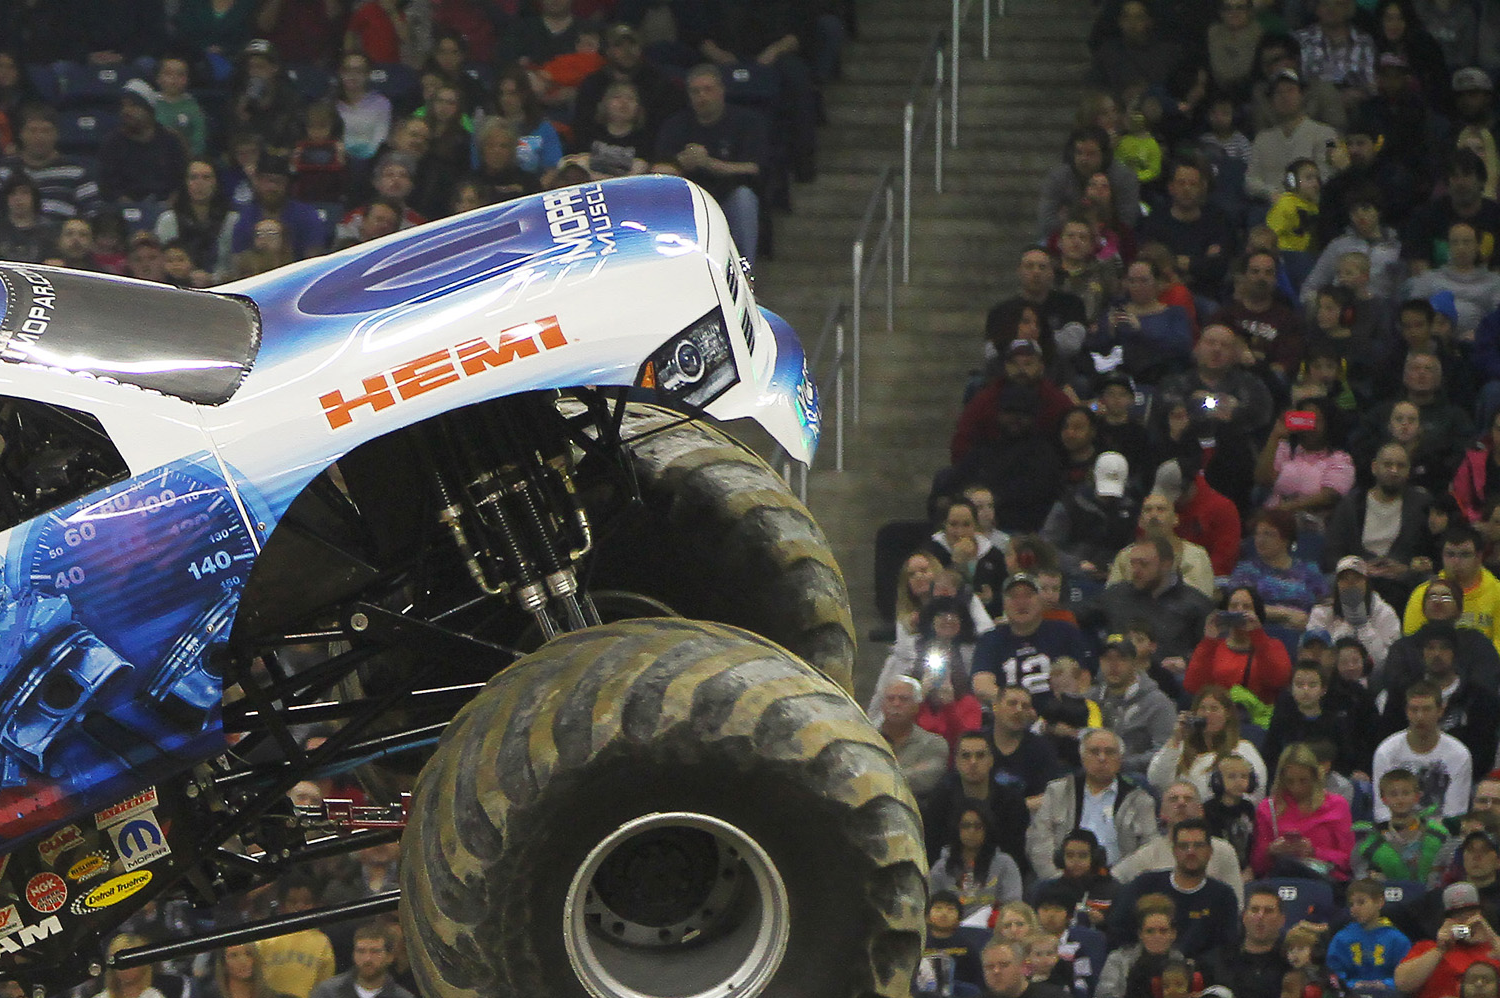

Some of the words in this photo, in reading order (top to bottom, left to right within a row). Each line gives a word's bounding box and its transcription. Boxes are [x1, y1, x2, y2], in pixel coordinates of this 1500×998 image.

[586, 184, 618, 255] MUSCL
[318, 315, 567, 430] HEMI
[136, 489, 176, 517] 100
[64, 523, 96, 546] 60
[209, 529, 229, 544] 130
[49, 548, 63, 559] 50
[187, 550, 232, 580] 140
[55, 567, 85, 589] 40
[1002, 653, 1051, 694] 12
[128, 848, 166, 868] MOPAR
[30, 878, 57, 896] NGK
[89, 888, 114, 904] Detroit
